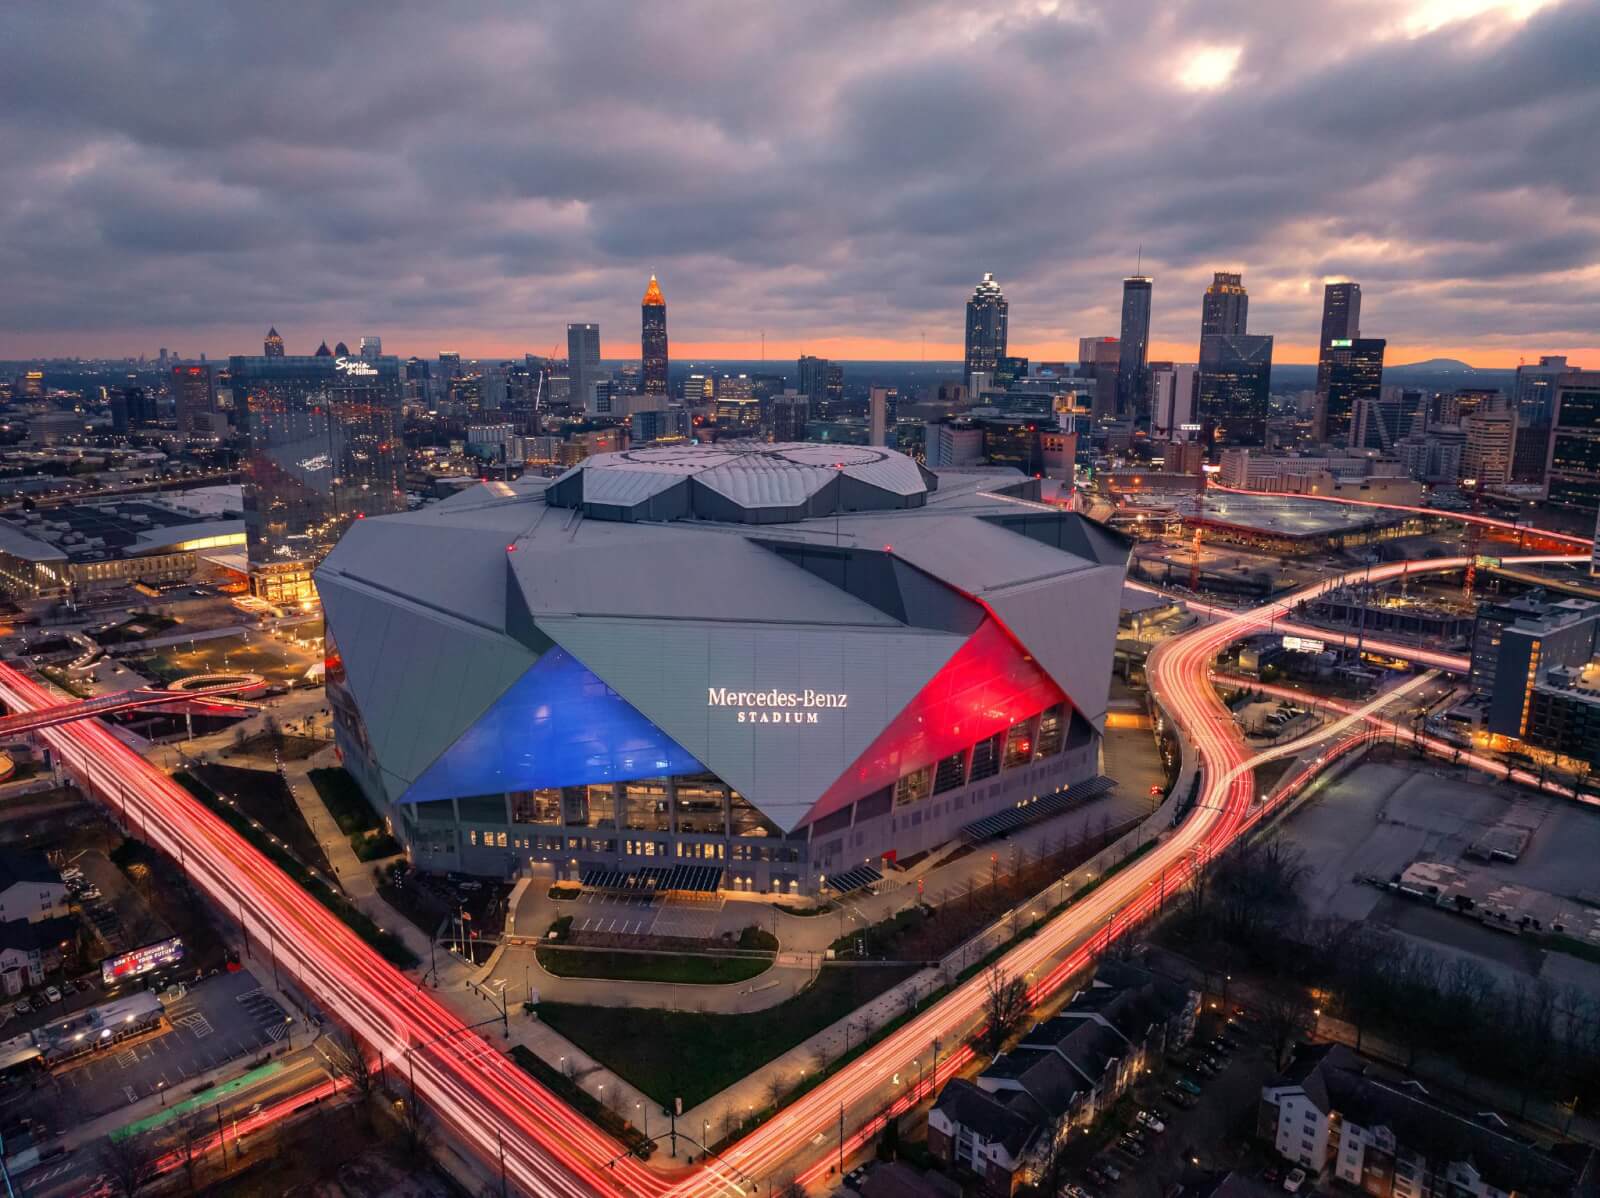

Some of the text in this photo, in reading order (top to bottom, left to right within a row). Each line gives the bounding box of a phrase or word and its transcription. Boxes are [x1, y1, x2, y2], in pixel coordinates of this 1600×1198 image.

[336, 357, 370, 375] Signia
[707, 688, 847, 707] Mercedes-Benz
[737, 712, 818, 723] STADIUM
